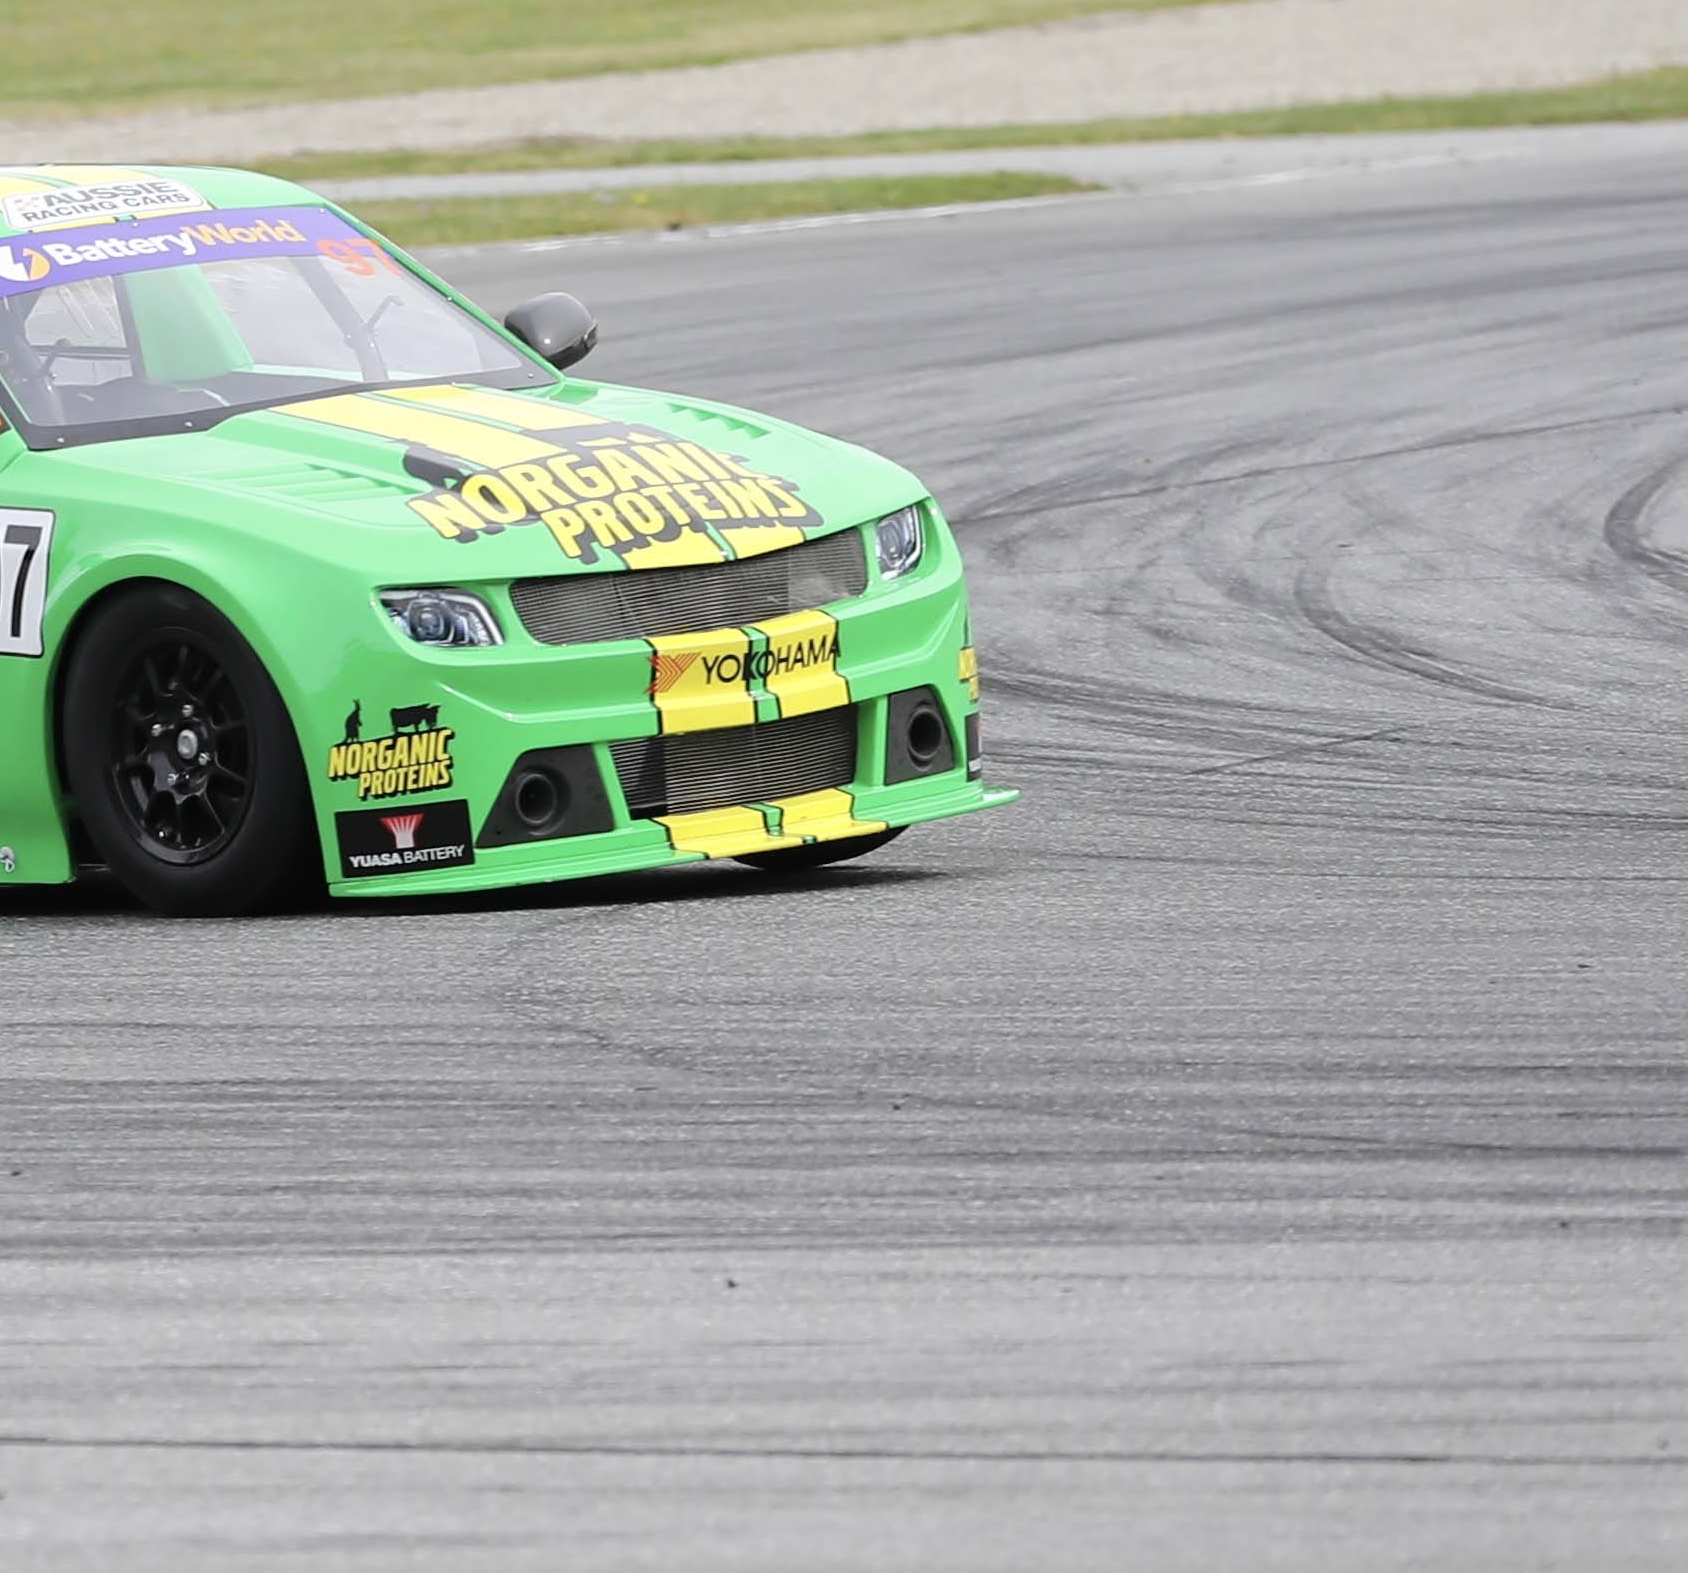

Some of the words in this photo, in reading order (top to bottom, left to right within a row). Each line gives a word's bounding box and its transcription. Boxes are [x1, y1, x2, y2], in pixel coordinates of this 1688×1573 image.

[22, 201, 118, 223] RACING
[124, 193, 191, 210] CARS
[42, 180, 177, 206] AUSSIE
[316, 237, 405, 277] 97
[408, 440, 770, 540] NORGANIC
[540, 478, 810, 559] PROTEINS
[702, 633, 842, 685] YOKOHAMA
[328, 729, 453, 778] NORGANIC
[358, 759, 451, 798] PROTEINS
[349, 852, 403, 868] YUASA
[403, 844, 466, 864] BATTERY
